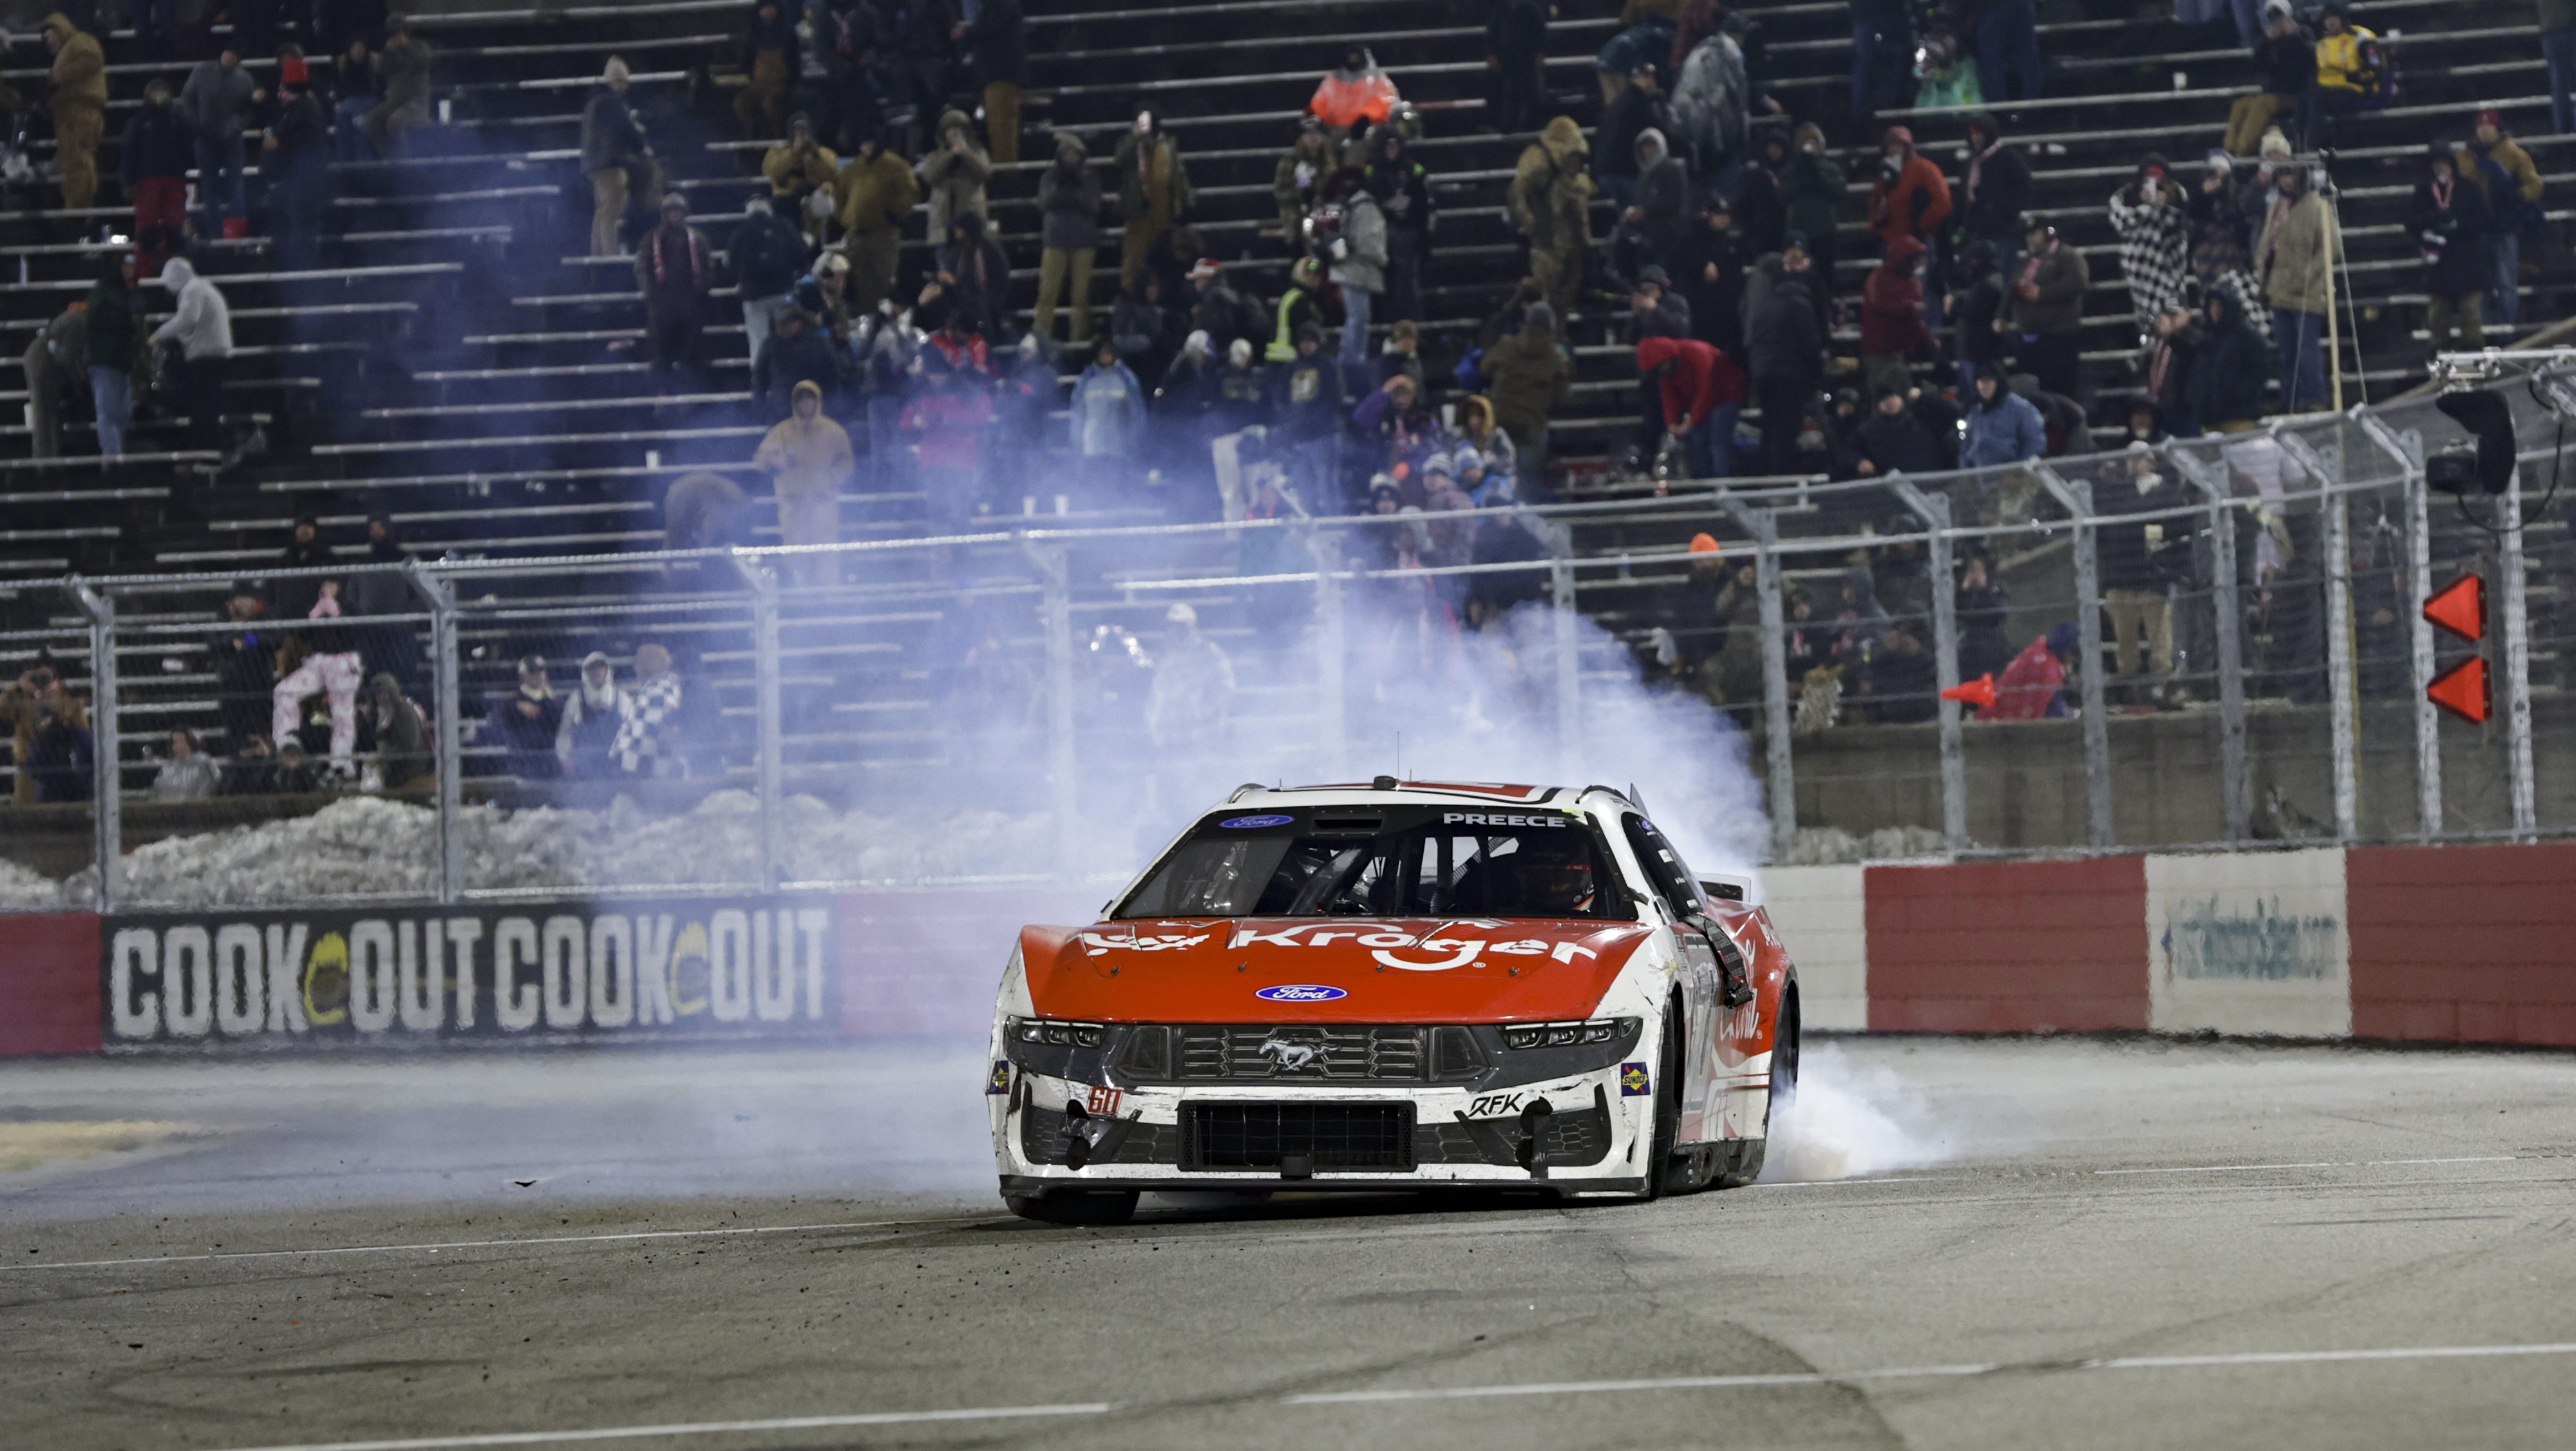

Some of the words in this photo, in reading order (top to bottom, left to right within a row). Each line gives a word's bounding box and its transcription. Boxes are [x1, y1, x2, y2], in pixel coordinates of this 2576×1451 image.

[1443, 813, 1566, 828] PREECE
[1227, 923, 1597, 971] Kroger
[1273, 987, 1331, 1000] Ford
[1624, 1075, 1646, 1085] SUNOCO
[1088, 1086, 1122, 1114] 60
[1468, 1092, 1524, 1117] RFK
